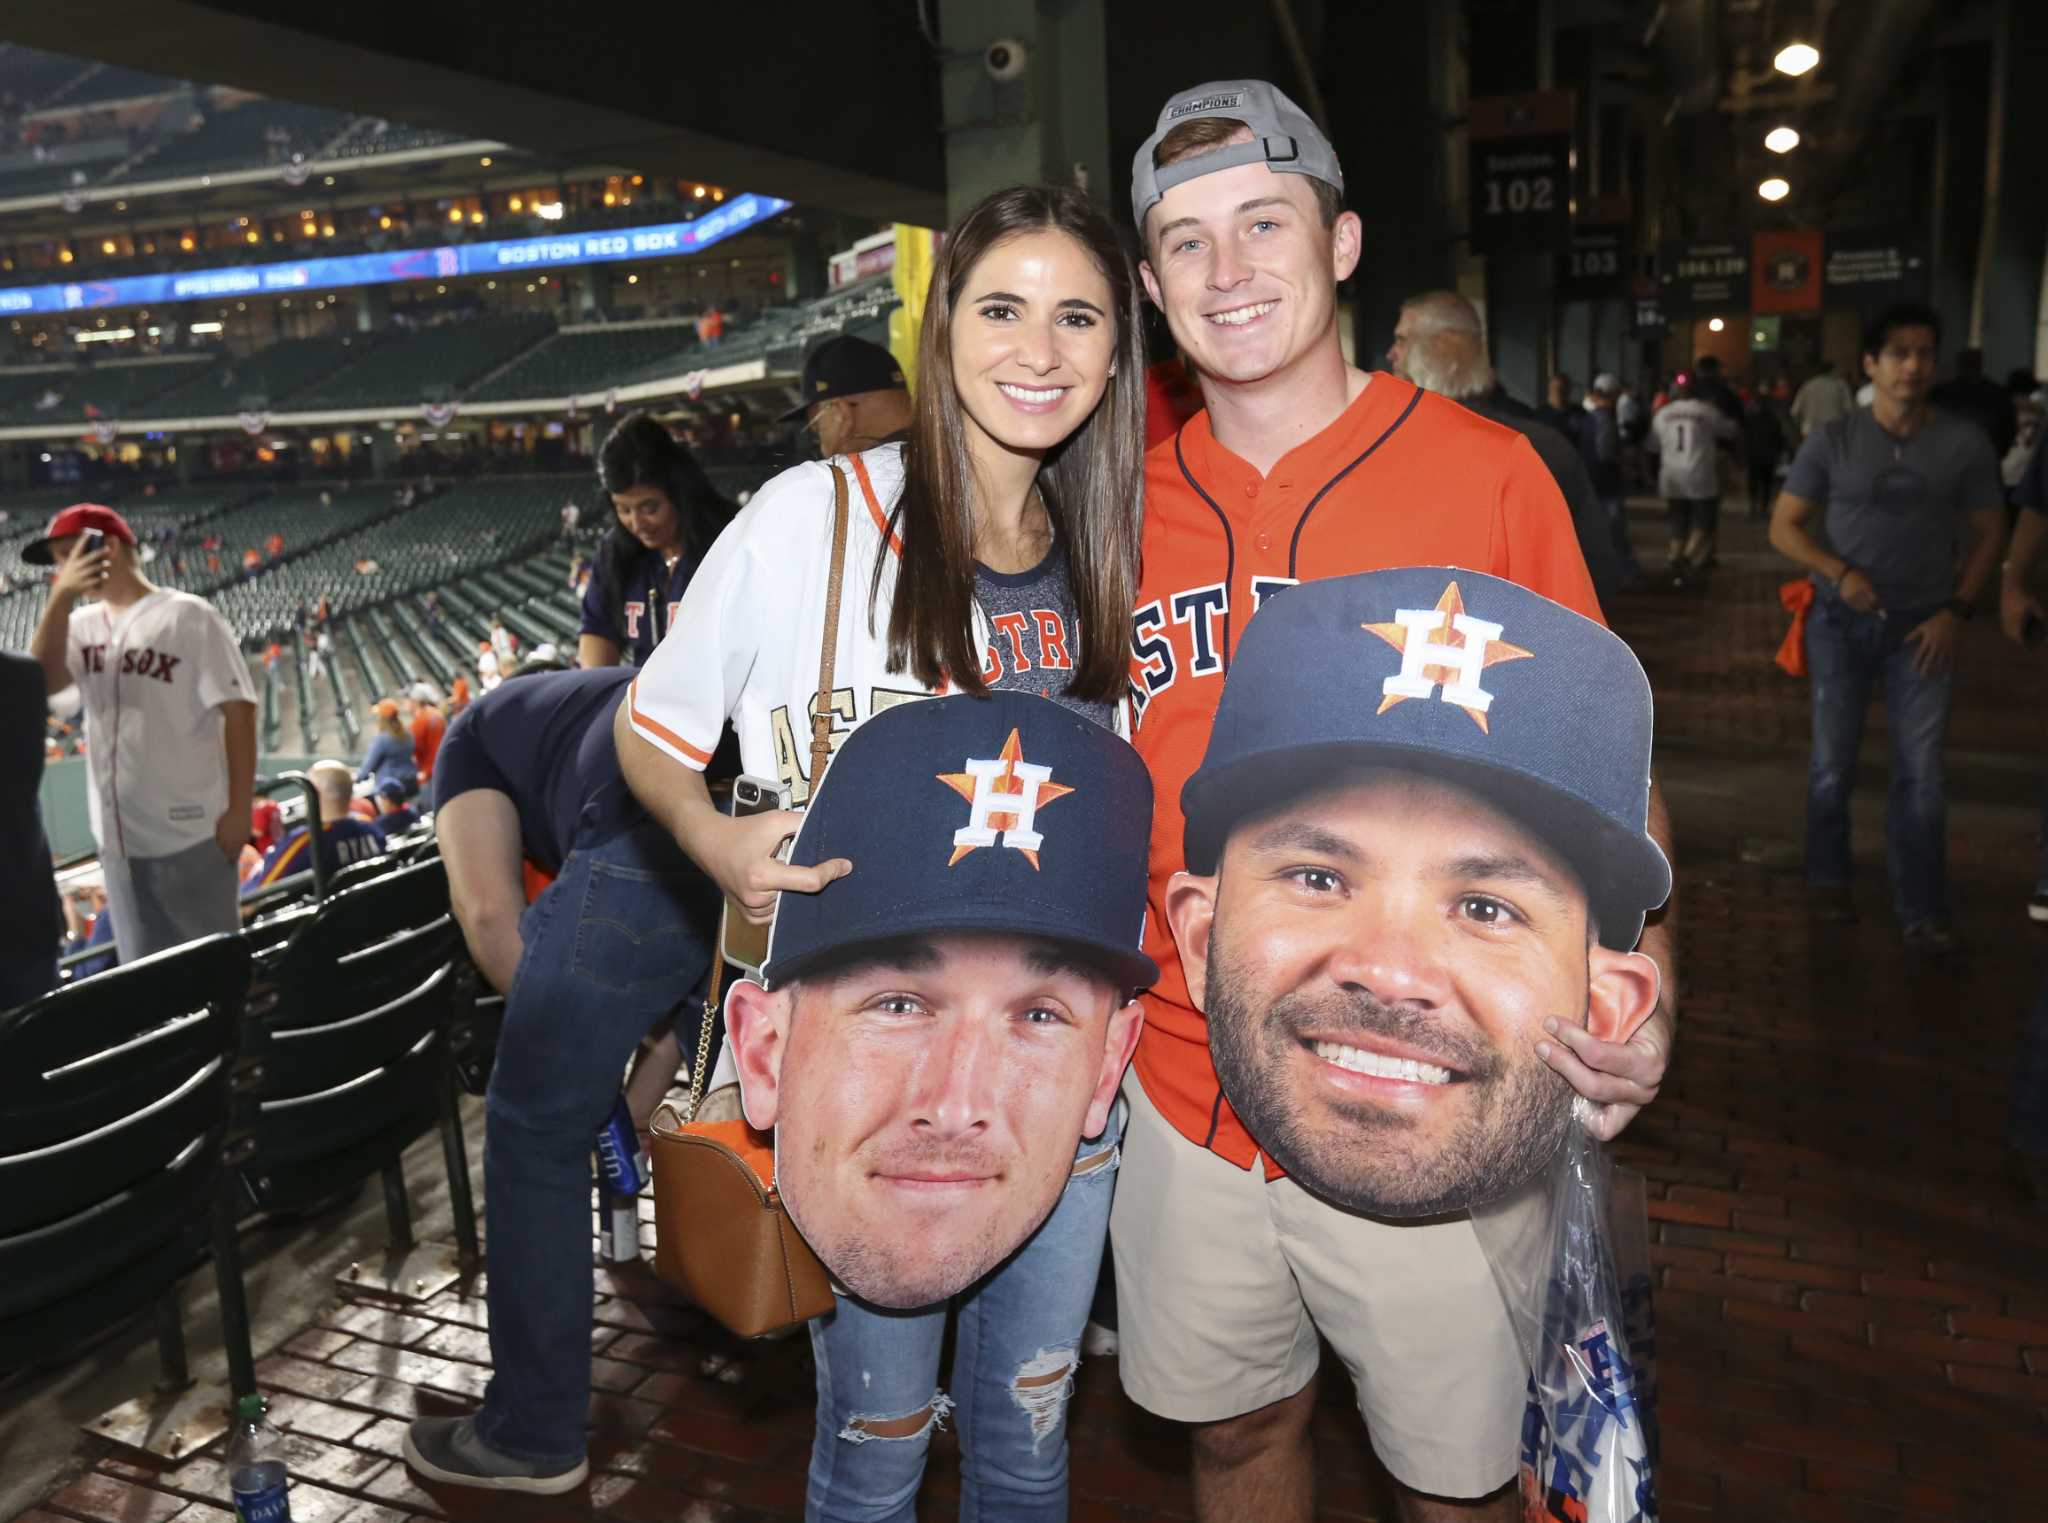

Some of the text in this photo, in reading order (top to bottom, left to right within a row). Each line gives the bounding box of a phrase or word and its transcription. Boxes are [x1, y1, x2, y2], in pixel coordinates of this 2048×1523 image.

[1170, 97, 1238, 117] CHAMPIONS
[1486, 178, 1553, 214] 102
[498, 231, 677, 265] BOSTON RED SOX
[1571, 252, 1617, 278] 103
[121, 647, 181, 684] SOX
[982, 609, 1081, 686] TR
[1383, 608, 1504, 712] H
[953, 758, 1053, 851] H
